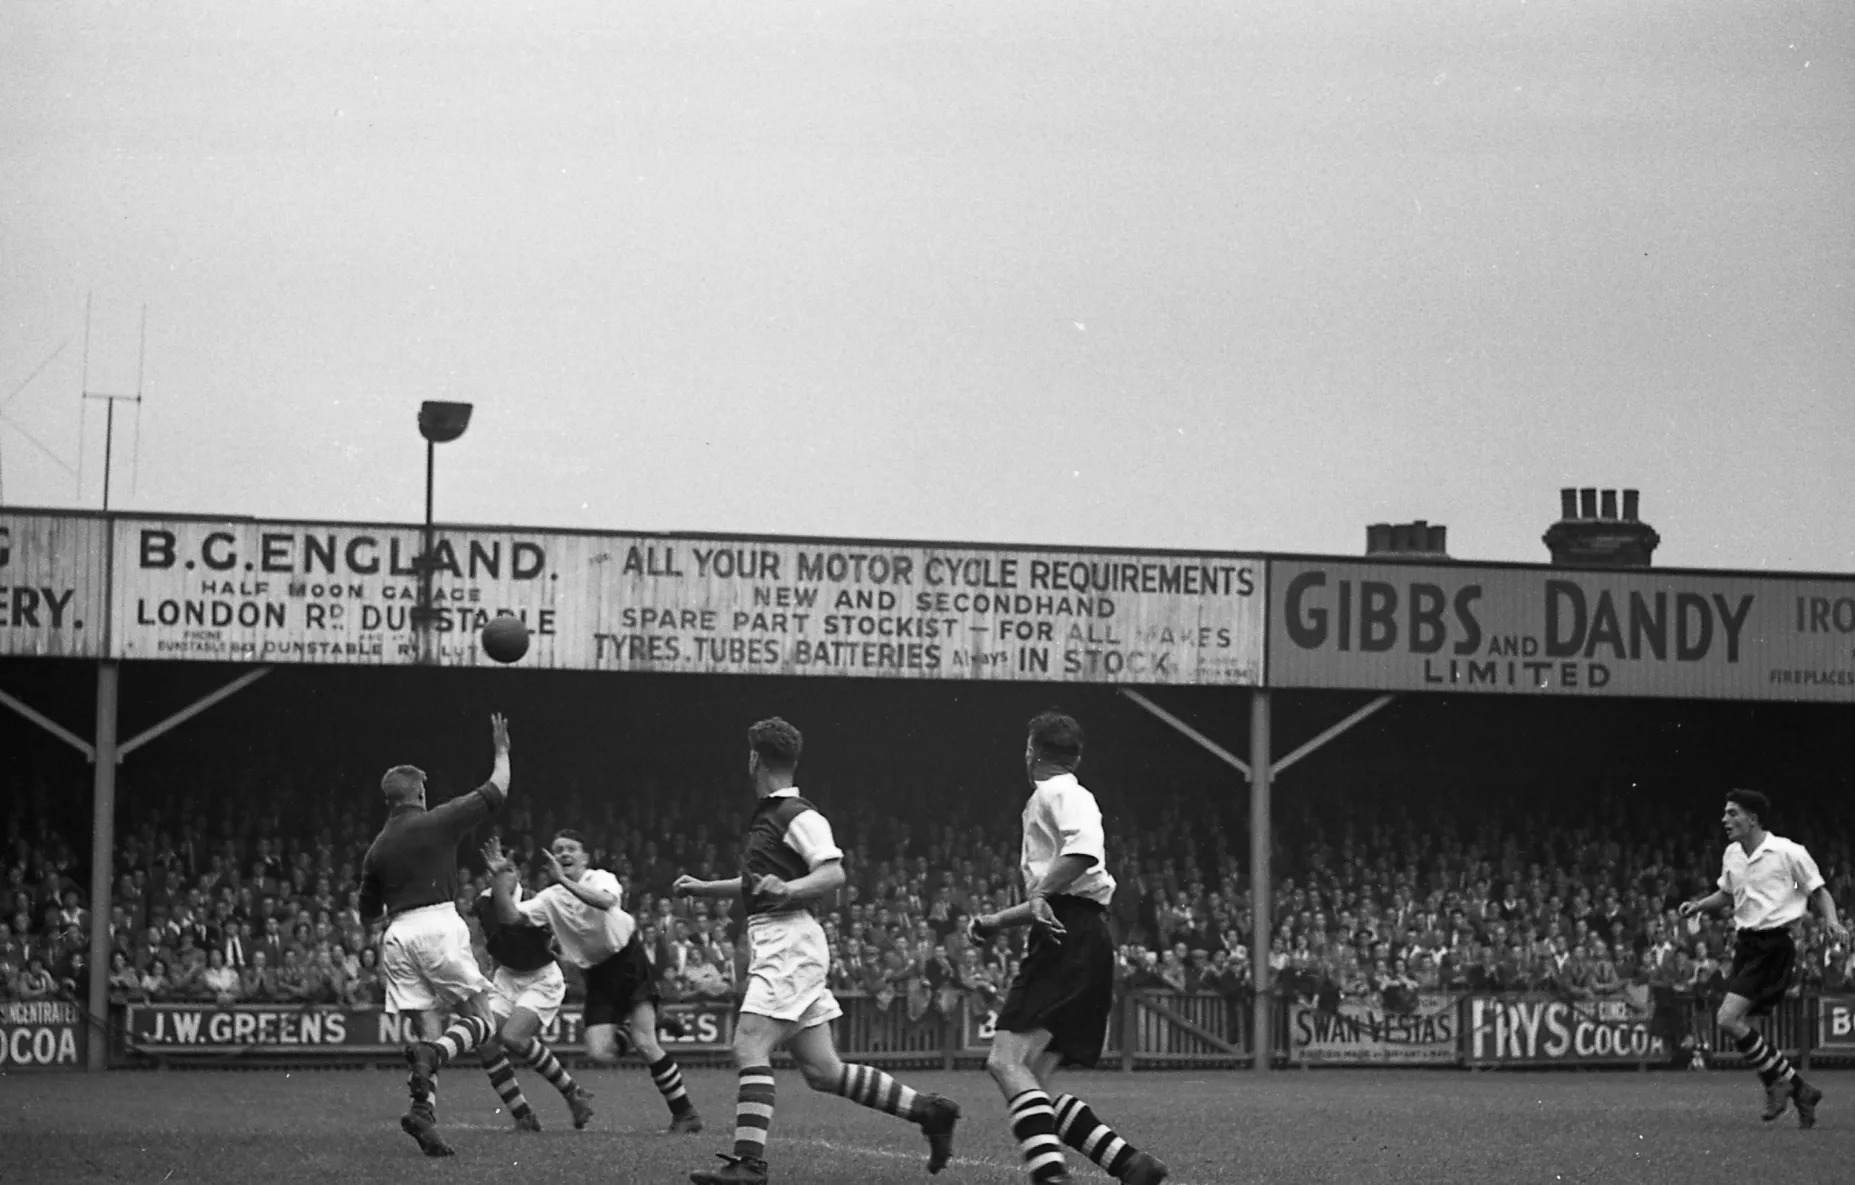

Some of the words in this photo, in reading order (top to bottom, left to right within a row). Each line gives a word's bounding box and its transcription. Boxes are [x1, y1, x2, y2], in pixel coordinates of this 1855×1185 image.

[623, 546, 683, 578] ALL
[691, 548, 780, 581] YOUR
[798, 551, 913, 585] MOTOR
[925, 556, 1018, 589] CYCLE
[1030, 559, 1255, 597] REQUIREMENTS
[202, 580, 270, 596] HALF
[289, 582, 364, 598] MOON
[382, 586, 481, 602] GAAGE
[754, 586, 819, 608] NEW
[834, 589, 896, 611] AND
[916, 592, 1116, 619] SECONDHAND
[137, 599, 286, 629] LONDON
[362, 604, 557, 635] DUSTALE
[622, 608, 717, 631] SPARE
[733, 611, 810, 634] PART
[824, 614, 958, 639] STOCKIST
[1000, 619, 1054, 642] FOR
[1069, 623, 1121, 645] ALL
[1284, 571, 1482, 656] GIBBS
[1488, 631, 1538, 658] AND
[1544, 579, 1755, 664] DANDY
[263, 641, 383, 657] DUNSTABLE
[795, 639, 941, 670] BATTERIES
[1019, 647, 1049, 673] IN
[1425, 658, 1611, 688] LIMITED
[1296, 1009, 1360, 1045] SWAN
[1368, 1010, 1452, 1044] VESTAS
